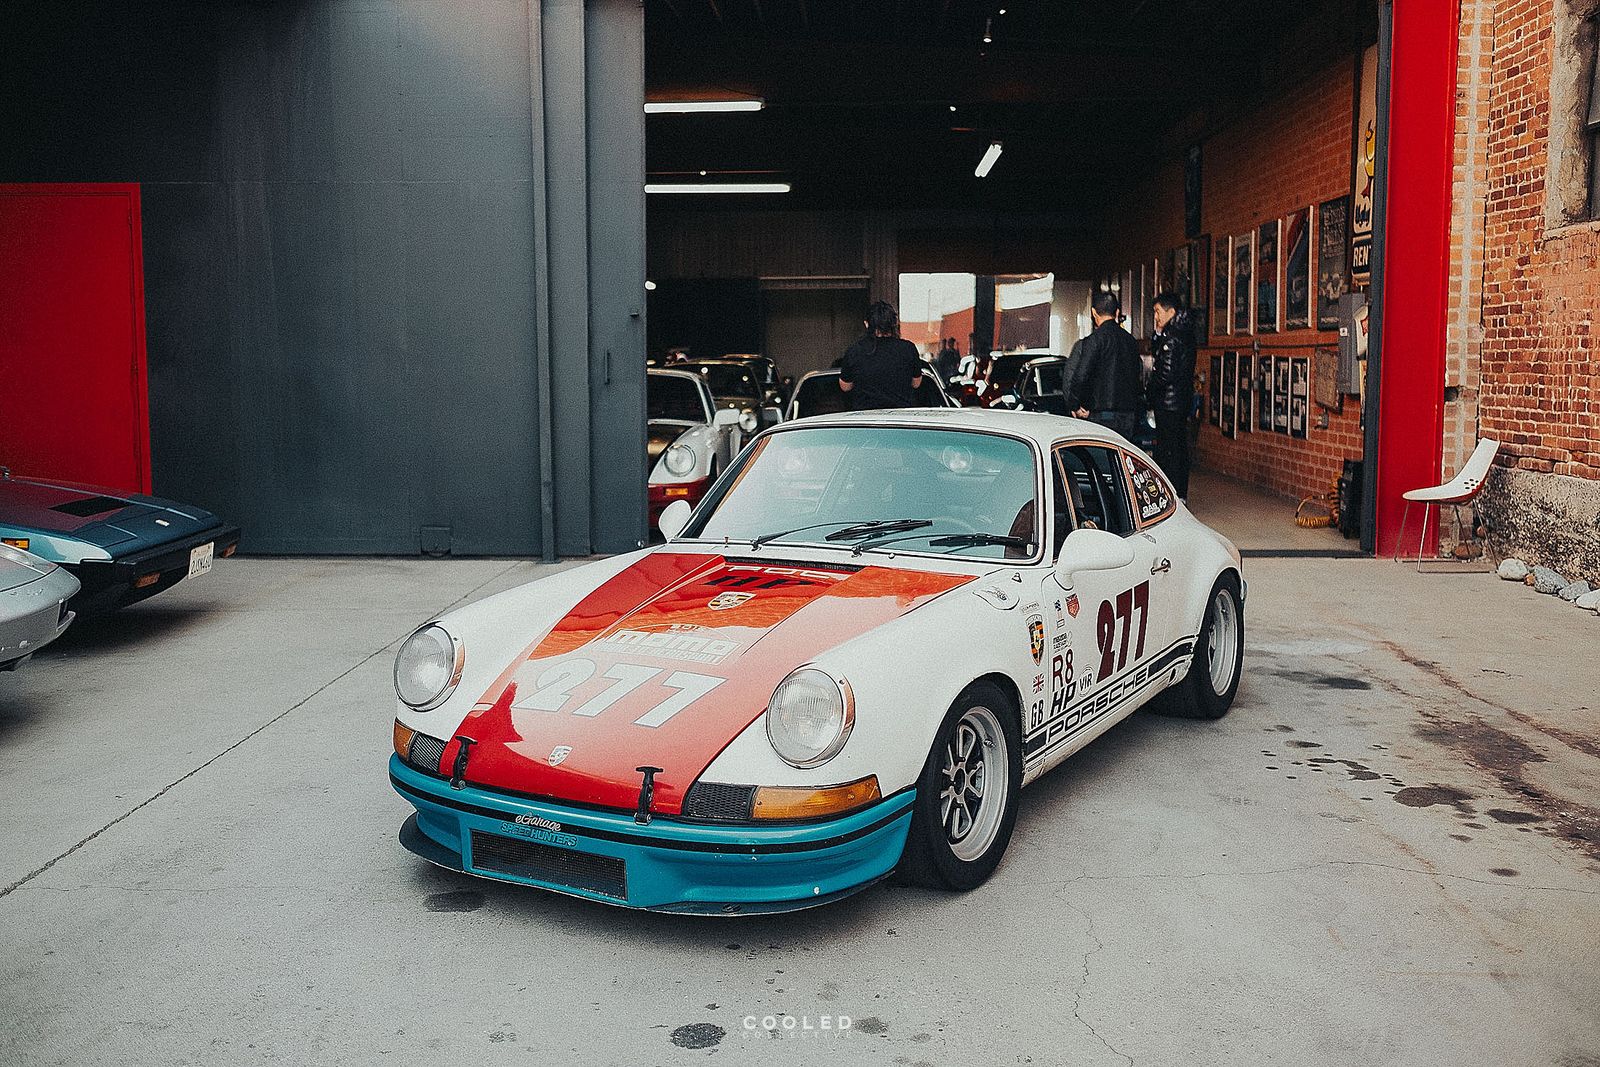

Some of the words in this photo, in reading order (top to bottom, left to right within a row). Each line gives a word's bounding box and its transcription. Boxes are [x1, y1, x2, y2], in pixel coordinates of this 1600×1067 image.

[1352, 244, 1371, 267] REN
[603, 629, 742, 657] momo
[1096, 579, 1150, 684] 277
[1052, 648, 1074, 692] R8
[511, 657, 730, 729] 277
[1048, 667, 1150, 742] PORSCHE
[1050, 681, 1077, 717] HP
[1031, 701, 1044, 729] GB
[515, 811, 562, 832] eGarage
